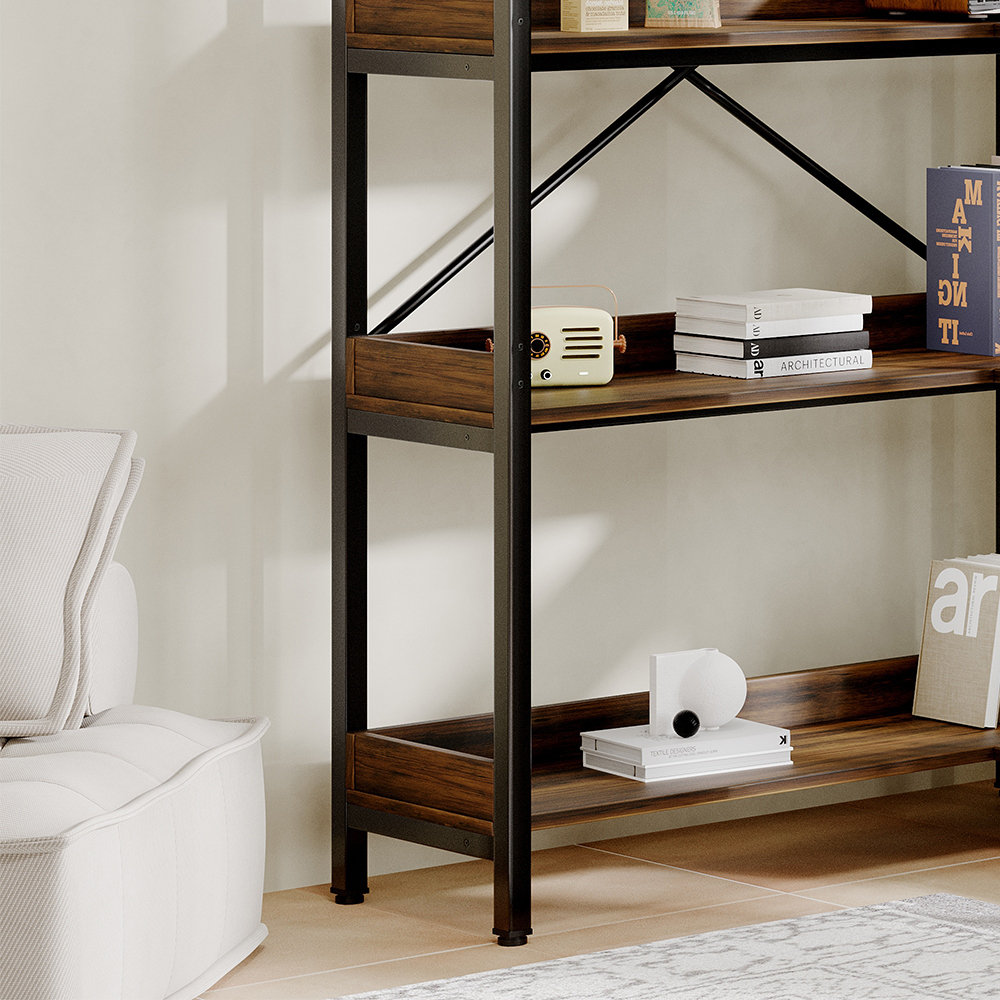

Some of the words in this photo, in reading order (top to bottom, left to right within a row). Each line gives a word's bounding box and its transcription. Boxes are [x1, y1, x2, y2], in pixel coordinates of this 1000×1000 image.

[753, 360, 764, 377] ar
[780, 354, 865, 372] ARCHITECTURAL
[931, 567, 999, 638] ar
